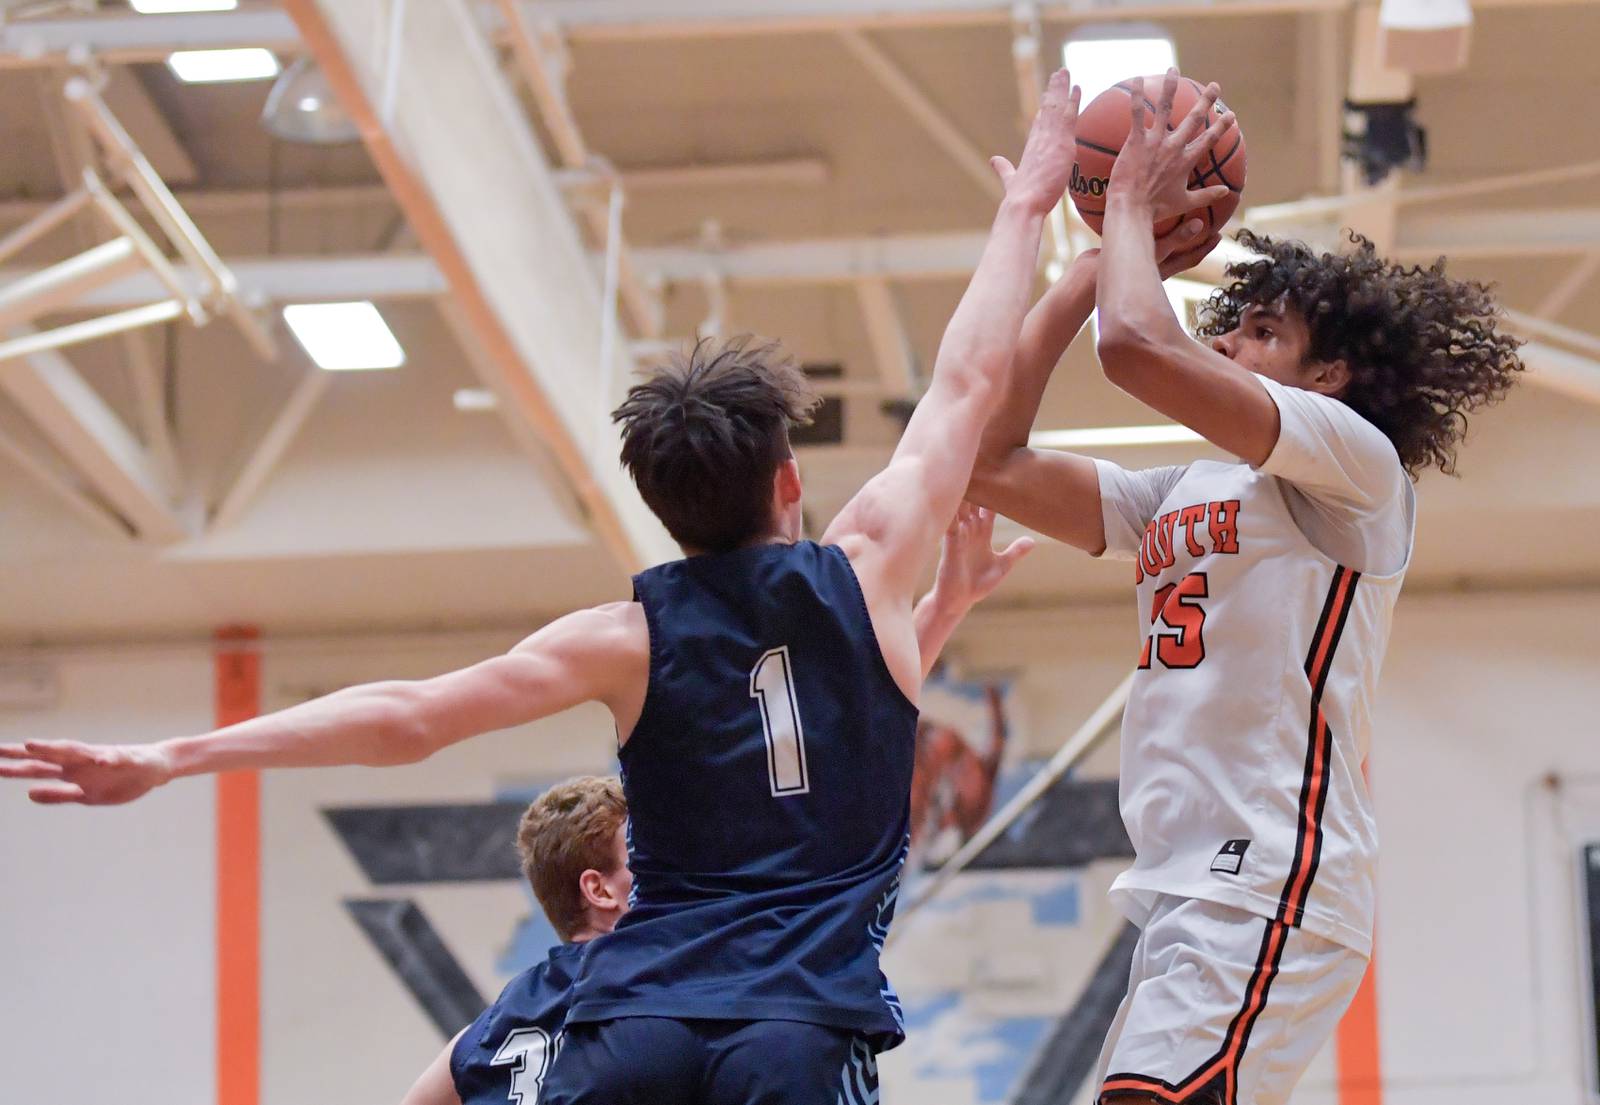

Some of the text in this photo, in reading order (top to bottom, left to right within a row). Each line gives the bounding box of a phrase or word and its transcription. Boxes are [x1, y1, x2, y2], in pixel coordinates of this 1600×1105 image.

[1136, 499, 1240, 585] OUTH
[749, 644, 810, 798] 1
[1228, 841, 1236, 852] L
[489, 1026, 566, 1105] 3
